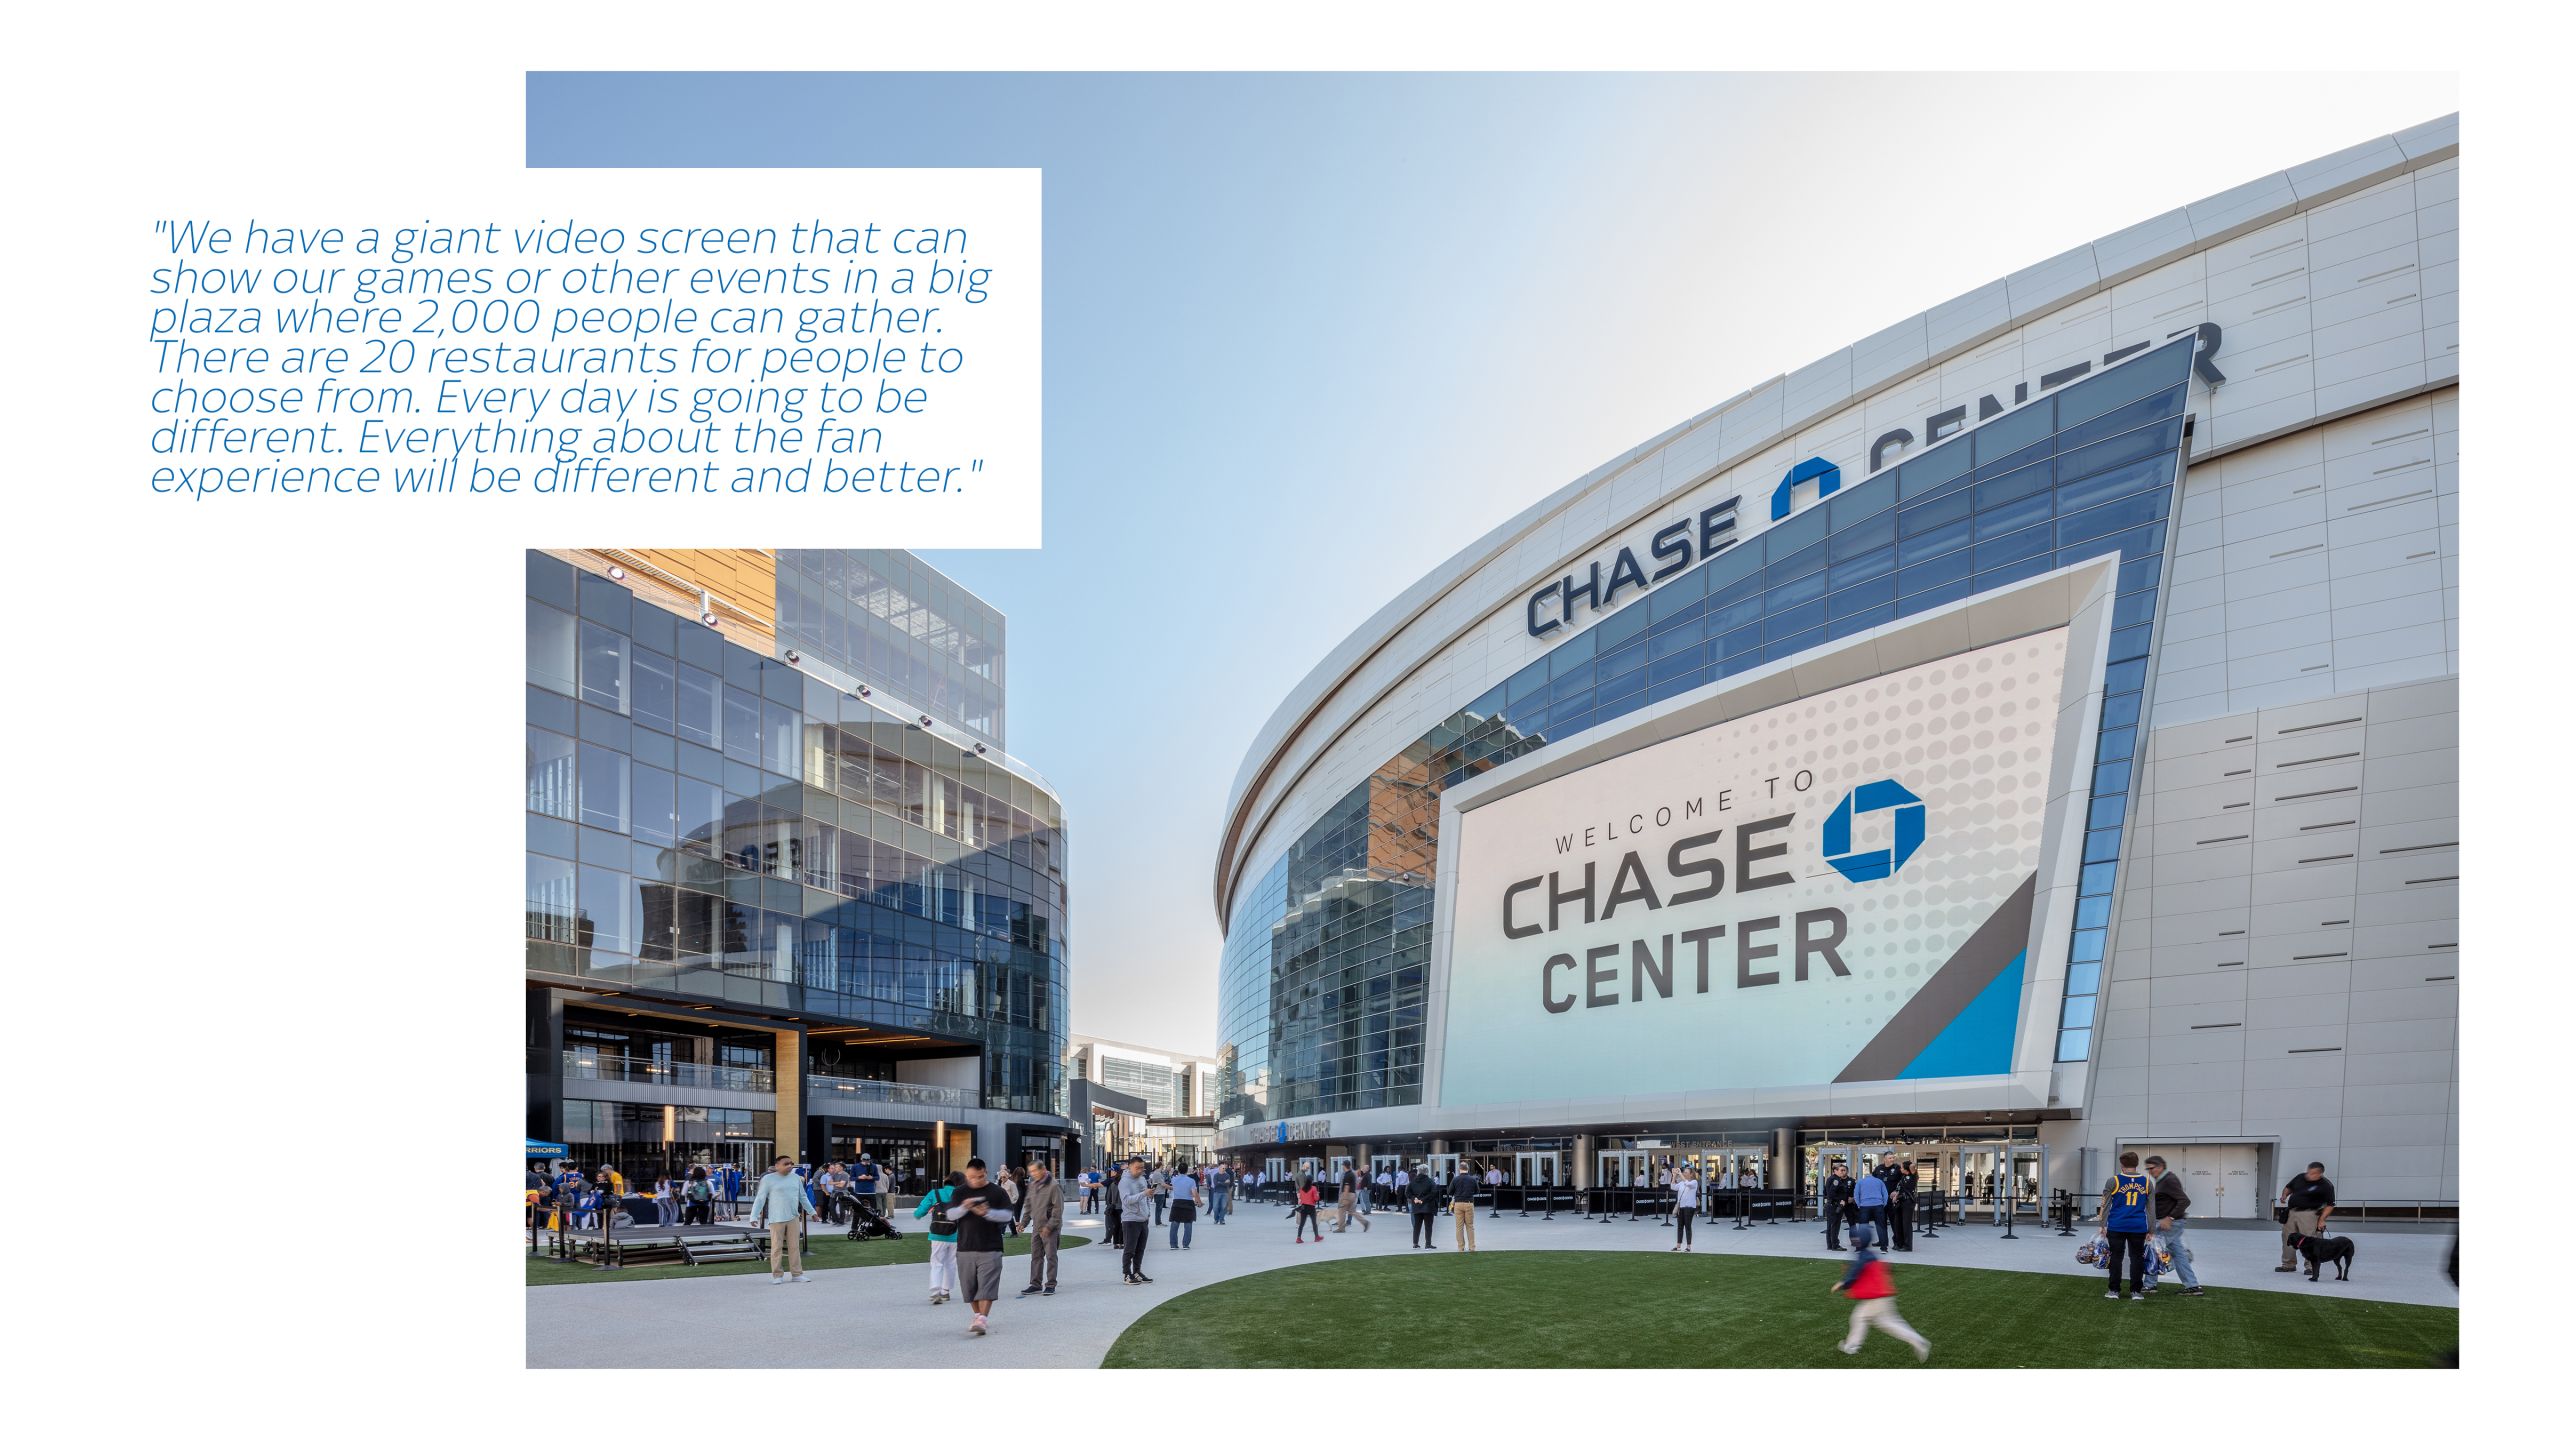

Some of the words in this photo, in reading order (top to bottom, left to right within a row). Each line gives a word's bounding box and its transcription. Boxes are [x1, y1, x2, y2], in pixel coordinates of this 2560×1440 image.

[1527, 494, 1742, 638] CHASE
[1869, 321, 2226, 475] CER
[1556, 789, 1732, 855] WELCOME
[1764, 769, 1814, 800] TO
[1502, 811, 1797, 941] CHASE
[1542, 906, 1852, 1015] CENTER
[1287, 1119, 1332, 1140] CENTER
[2125, 1191, 2138, 1206] 11
